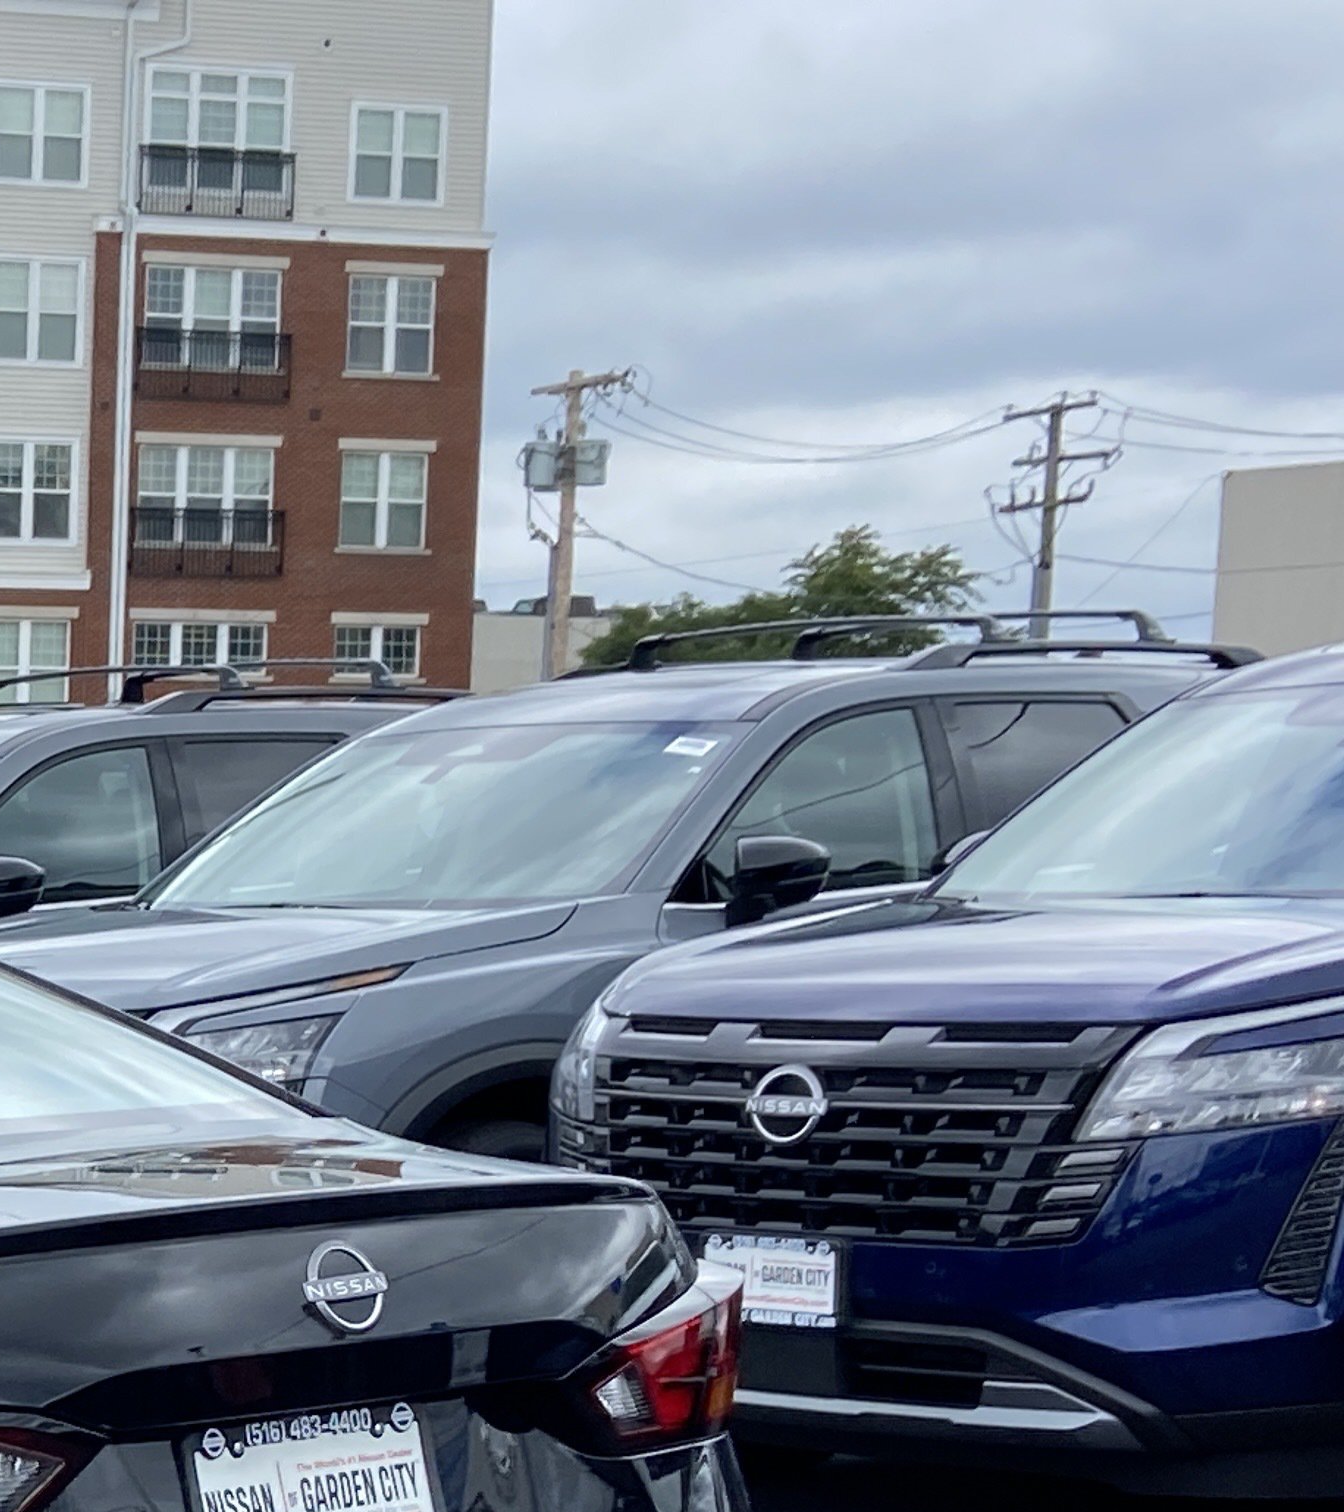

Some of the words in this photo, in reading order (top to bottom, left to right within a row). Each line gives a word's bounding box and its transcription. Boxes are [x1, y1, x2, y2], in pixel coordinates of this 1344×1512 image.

[745, 1098, 826, 1116] NISSAN
[762, 1264, 803, 1285] GARDEN
[805, 1269, 831, 1287] CITY
[306, 1276, 388, 1299] NISSAN
[245, 1420, 286, 1446] (516)
[290, 1408, 372, 1440] 483-4400
[379, 1462, 418, 1502] CITY
